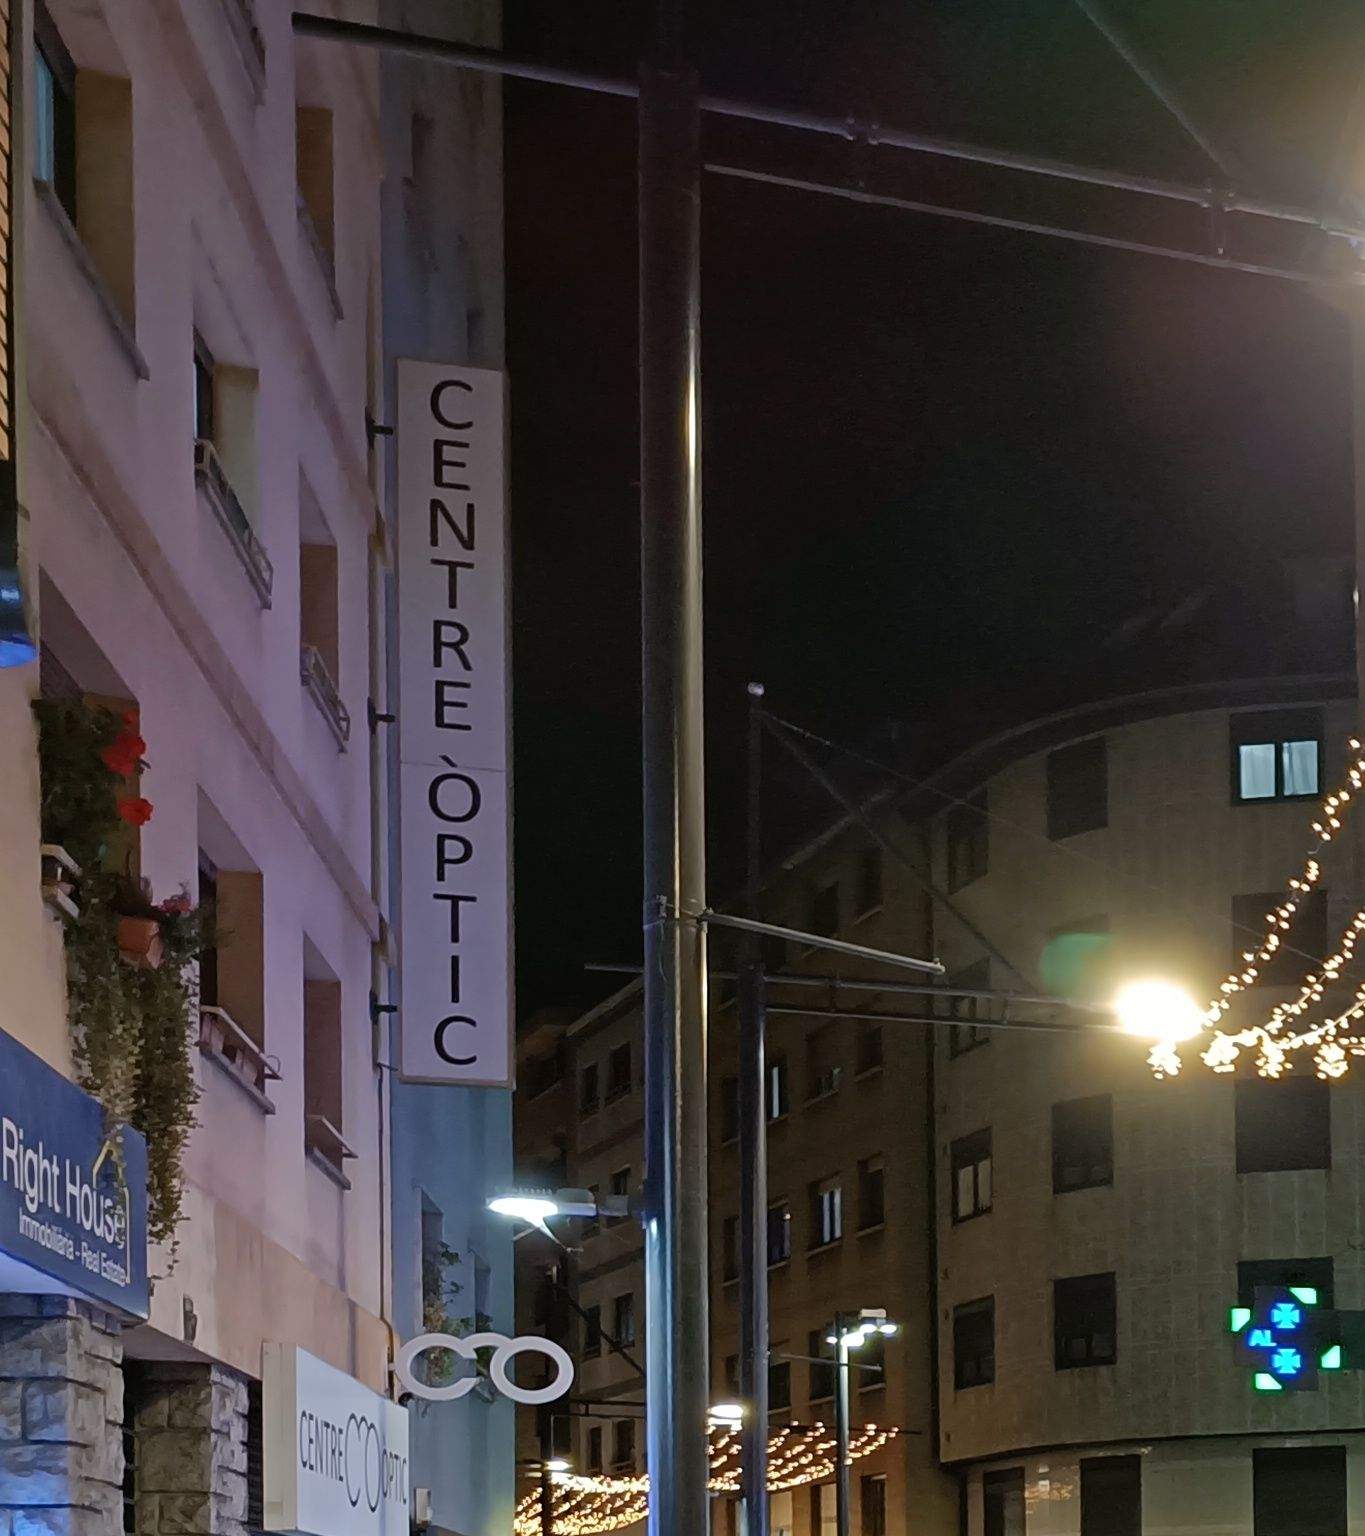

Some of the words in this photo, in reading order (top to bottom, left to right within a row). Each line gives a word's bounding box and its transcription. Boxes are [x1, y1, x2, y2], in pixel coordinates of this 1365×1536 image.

[429, 378, 475, 732] CENTRE
[428, 754, 482, 1066] ÒPTIC
[2, 1117, 61, 1214] Right
[65, 1158, 126, 1250] House
[299, 1409, 344, 1483] CENTRE
